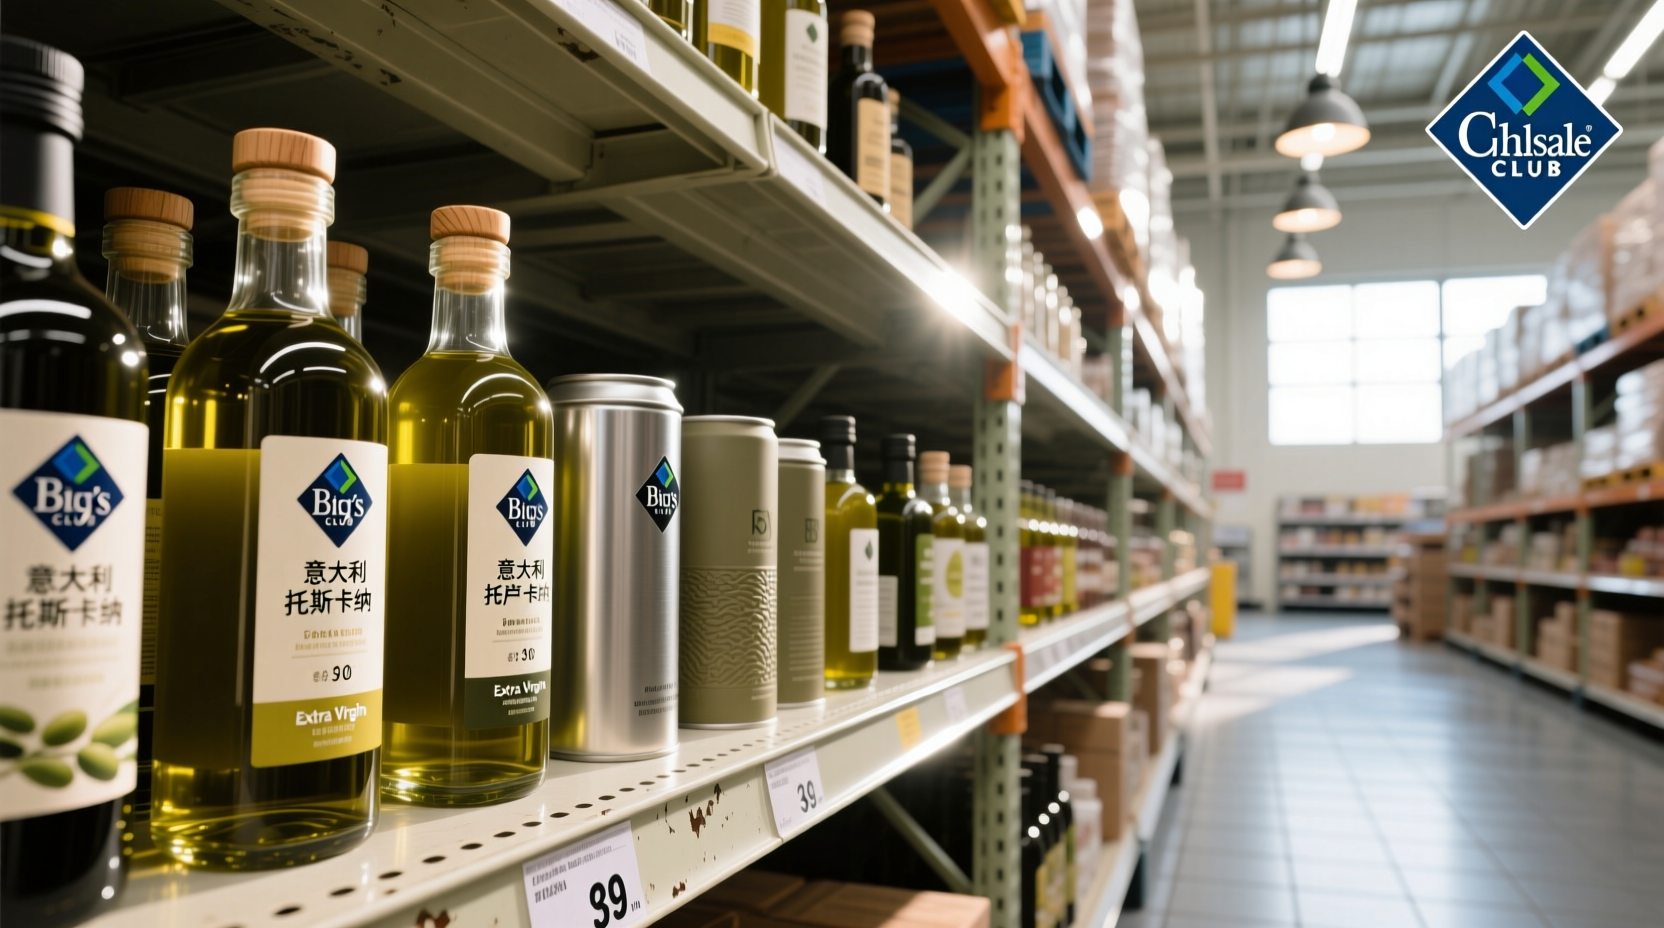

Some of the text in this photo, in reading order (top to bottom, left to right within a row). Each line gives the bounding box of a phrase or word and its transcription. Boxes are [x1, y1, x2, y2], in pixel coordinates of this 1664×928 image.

[34, 476, 111, 526] Big's
[26, 565, 112, 594] 意大利
[304, 560, 367, 585] 意大利
[497, 559, 545, 580] 意大利
[5, 597, 123, 631] 托斯卡纳
[285, 587, 372, 616] 托斯卡纳
[295, 708, 332, 726] Extra
[797, 780, 817, 813] 39
